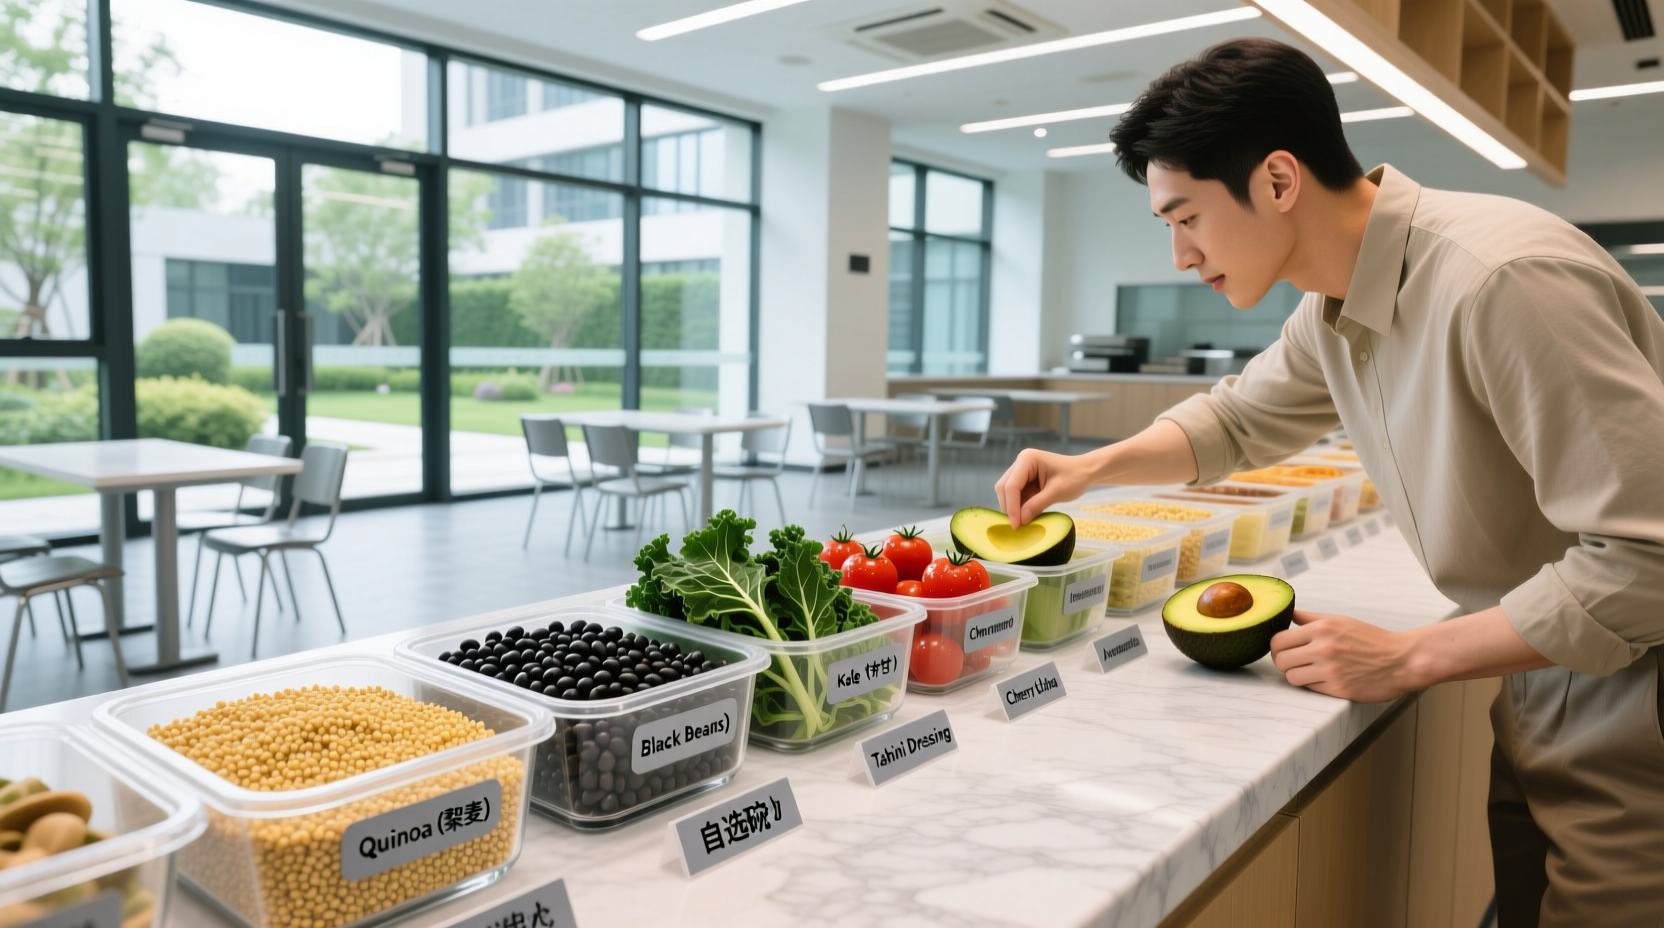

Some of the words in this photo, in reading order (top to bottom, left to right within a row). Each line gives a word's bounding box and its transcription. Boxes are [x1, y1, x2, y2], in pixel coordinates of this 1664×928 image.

[641, 729, 681, 757] Black
[685, 712, 730, 743] Beans)
[870, 740, 907, 768] Tahini
[359, 822, 433, 859] Quinoa
